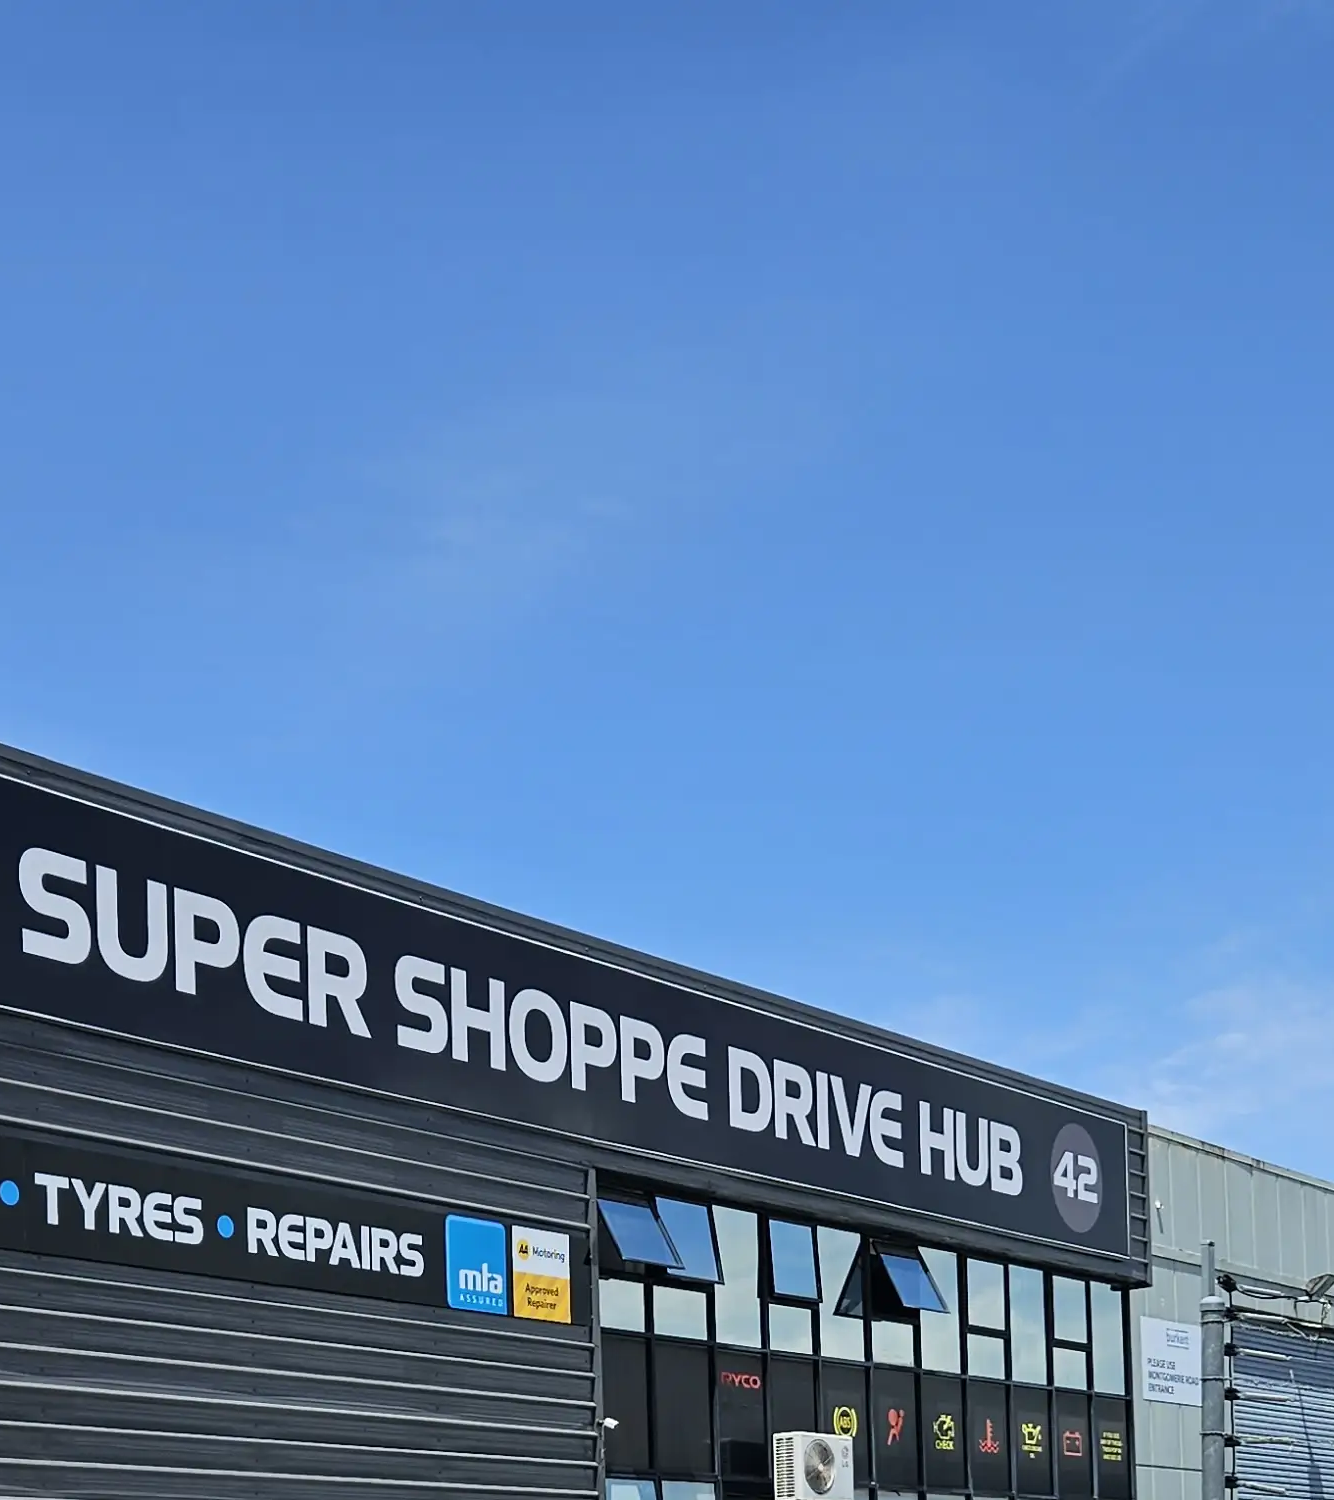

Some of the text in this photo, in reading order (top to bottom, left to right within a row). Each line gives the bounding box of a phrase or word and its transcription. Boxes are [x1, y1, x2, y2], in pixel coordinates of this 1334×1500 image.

[18, 847, 372, 1039] SUPER
[394, 955, 709, 1122] SHOPPE
[728, 1046, 903, 1168] DRIVE
[919, 1101, 1022, 1195] HUB
[1054, 1152, 1097, 1203] 42
[35, 1173, 203, 1244] TYRES
[248, 1216, 425, 1278] REPAIRS
[532, 1245, 565, 1263] Motoring
[525, 1282, 559, 1297] Approved
[459, 1293, 503, 1307] ASSURED
[527, 1297, 557, 1310] Repairer
[721, 1371, 761, 1389] RYCO
[1148, 1382, 1175, 1396] ENTRANCE
